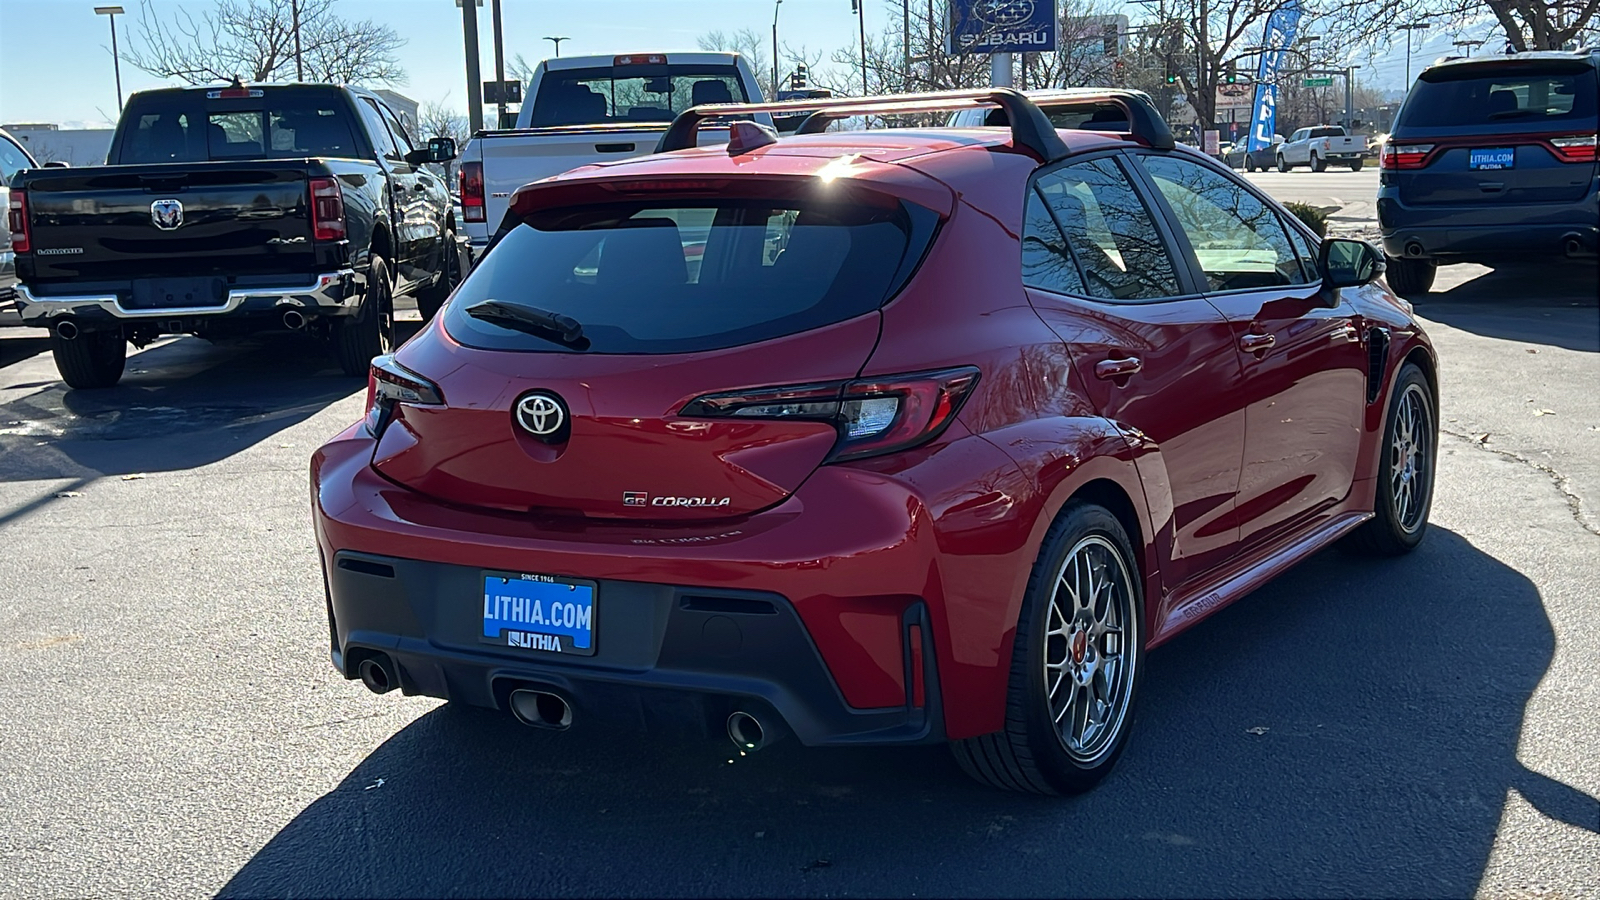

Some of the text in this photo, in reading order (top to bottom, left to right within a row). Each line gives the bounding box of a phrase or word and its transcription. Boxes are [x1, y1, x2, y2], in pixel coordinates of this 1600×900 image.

[960, 32, 1047, 46] SUBARU
[1470, 154, 1513, 163] LITHIA.COM
[37, 247, 84, 255] LARAMIE
[624, 496, 731, 508] GR COROLLA
[521, 574, 539, 582] SINCE
[484, 594, 592, 631] LITHIA.COM
[520, 632, 562, 652] LITHIA
